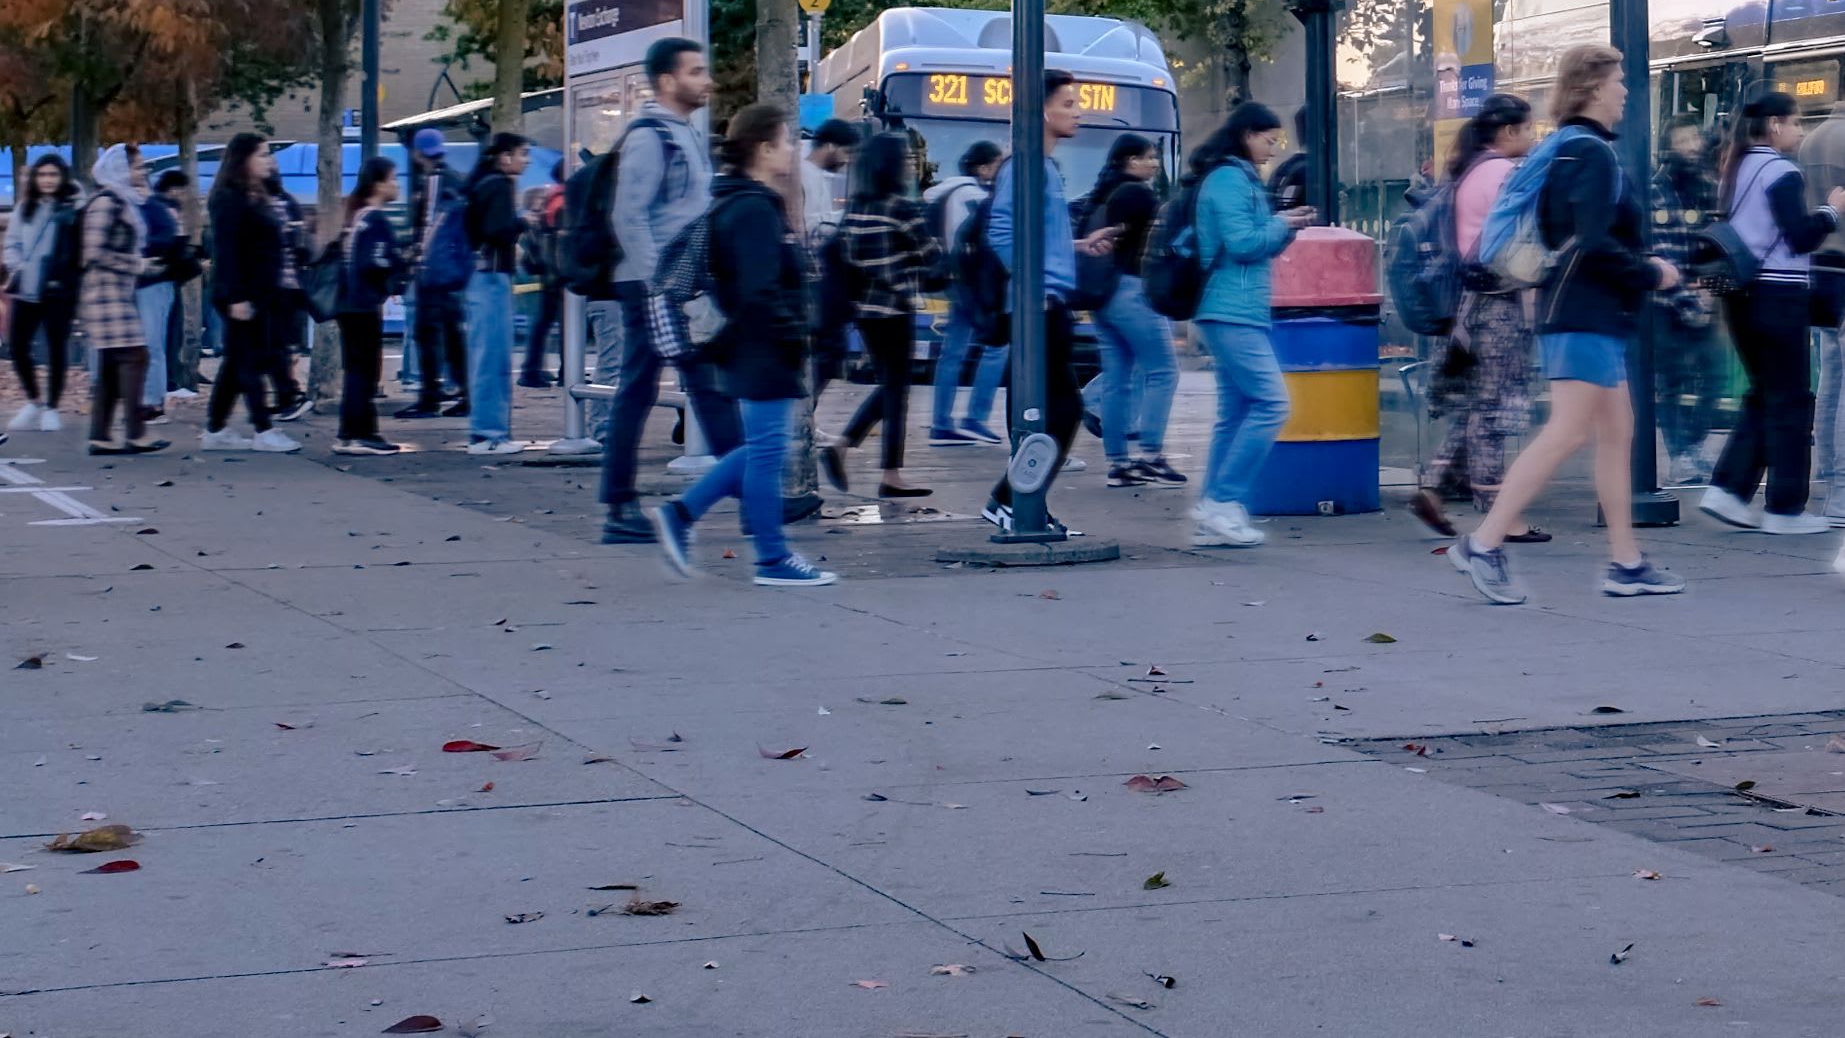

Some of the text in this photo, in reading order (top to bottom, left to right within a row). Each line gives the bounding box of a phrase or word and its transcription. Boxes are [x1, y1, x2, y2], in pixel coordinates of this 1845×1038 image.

[929, 74, 968, 104] 321
[1079, 84, 1116, 110] STN
[1468, 76, 1488, 91] Giving
